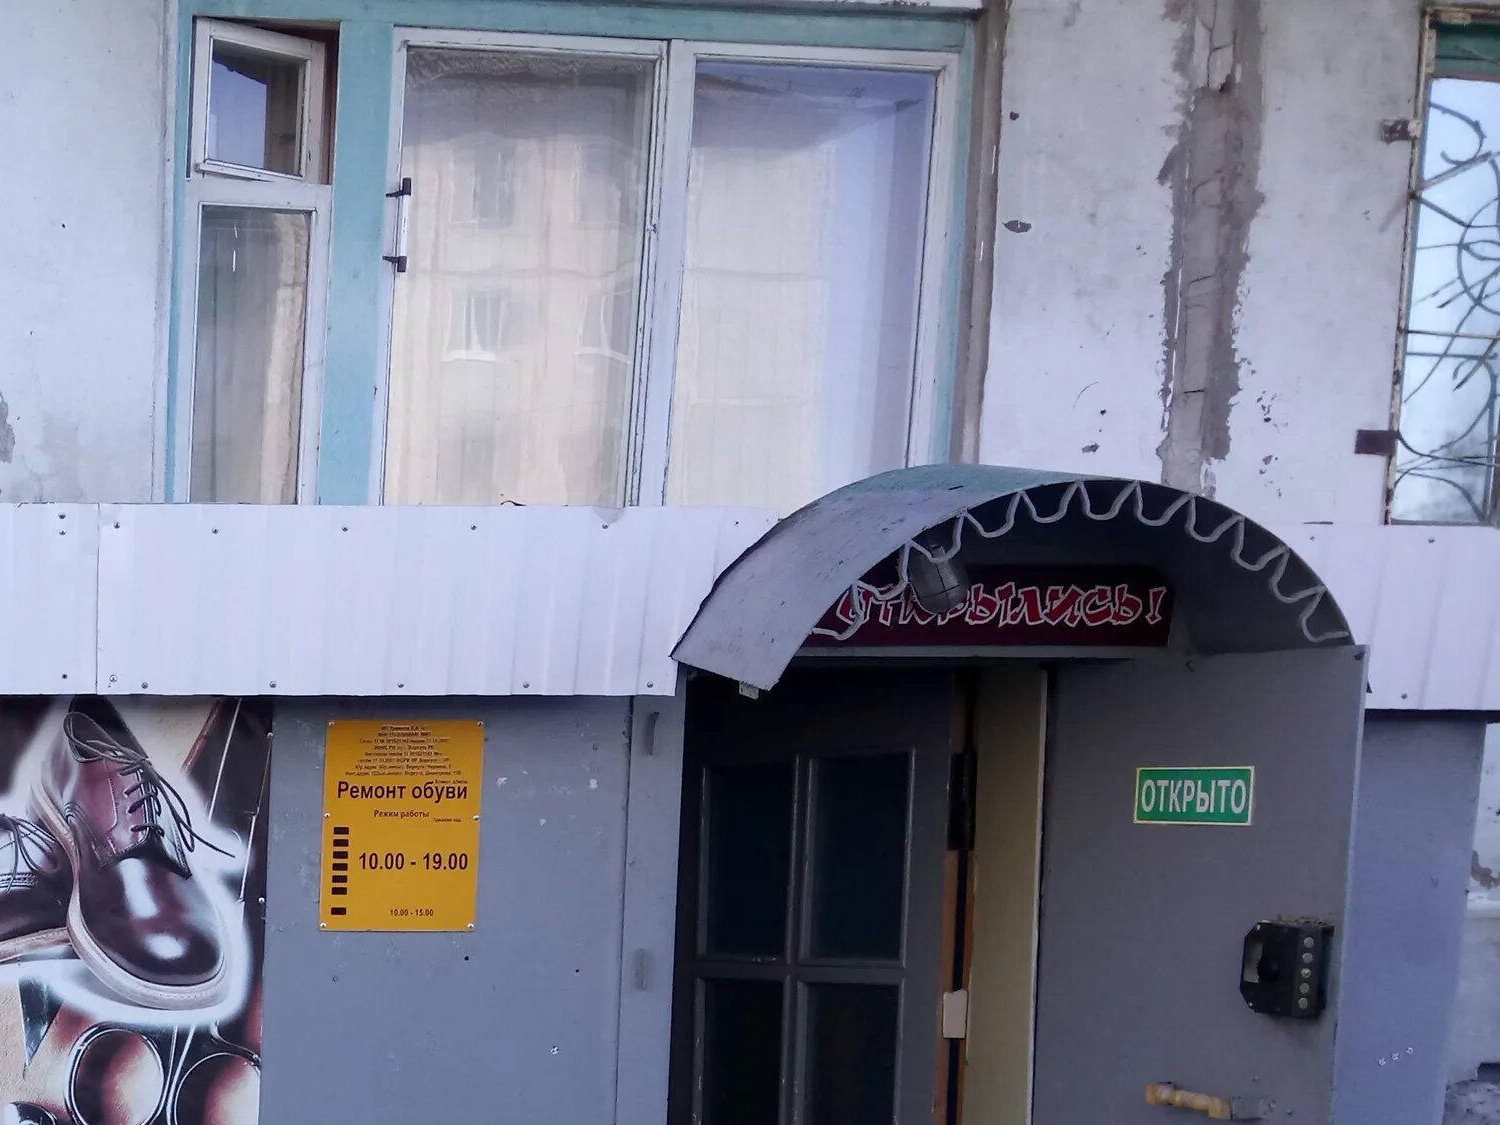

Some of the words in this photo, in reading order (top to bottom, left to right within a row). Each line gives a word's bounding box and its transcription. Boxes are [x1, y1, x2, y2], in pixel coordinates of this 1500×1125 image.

[337, 781, 407, 800] Ремонт
[411, 780, 468, 804] обуви
[1141, 779, 1247, 815] ОТКРЫТО
[373, 809, 399, 818] Режим
[400, 809, 430, 820] работы
[359, 852, 405, 870] 10.00
[423, 852, 469, 870] 19.00
[389, 908, 409, 917] 10.00
